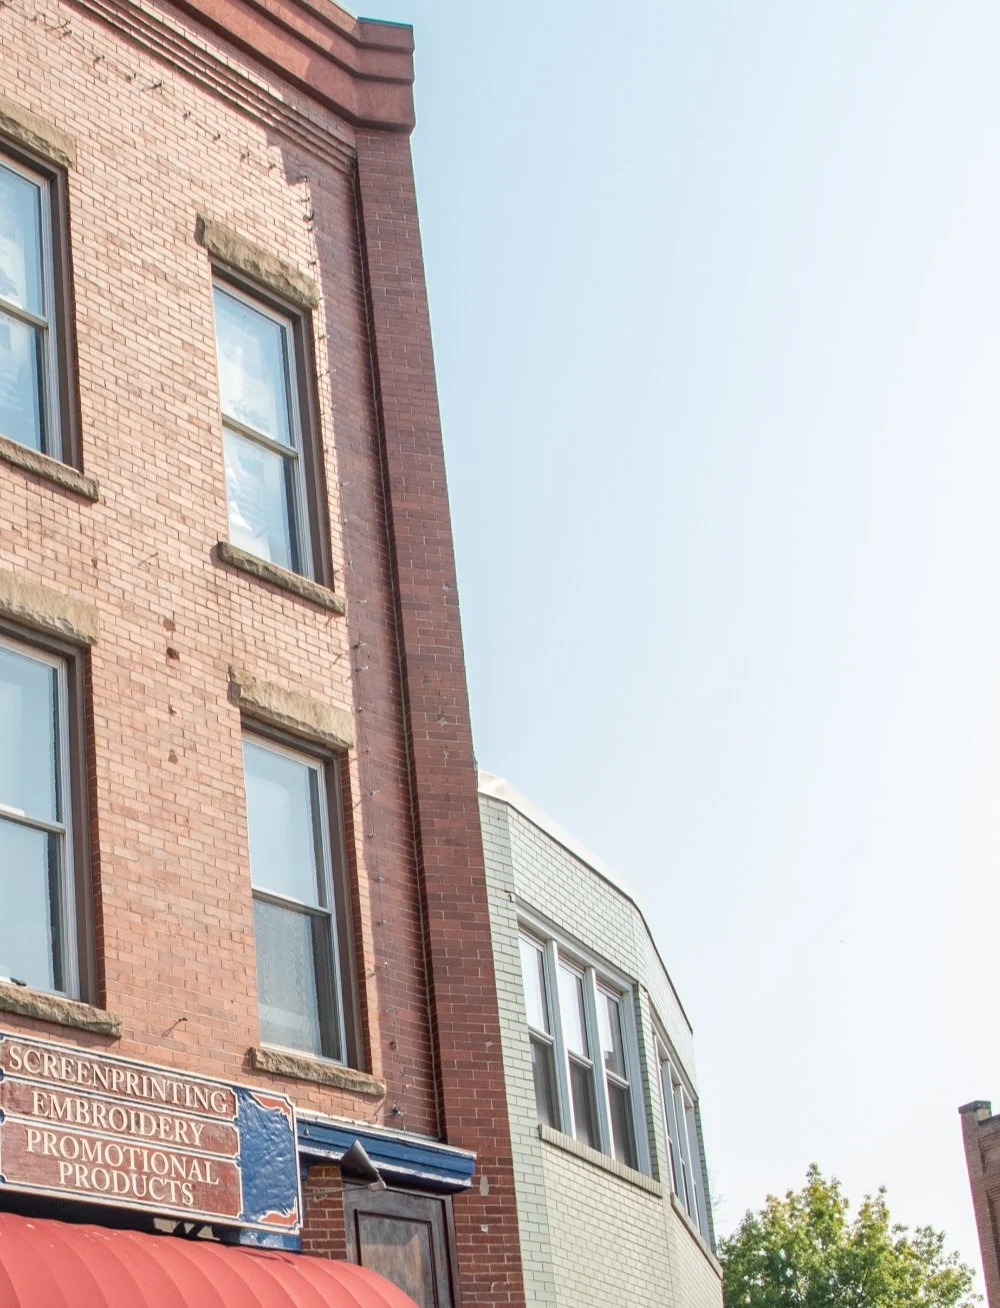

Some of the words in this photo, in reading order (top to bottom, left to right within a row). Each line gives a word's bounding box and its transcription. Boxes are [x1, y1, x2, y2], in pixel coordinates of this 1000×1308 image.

[8, 1045, 229, 1114] SCREENPRINTING
[31, 1090, 206, 1147] EMBROIDERY
[25, 1128, 220, 1186] PROMOTIONAL
[57, 1160, 194, 1206] PRODUCTS
